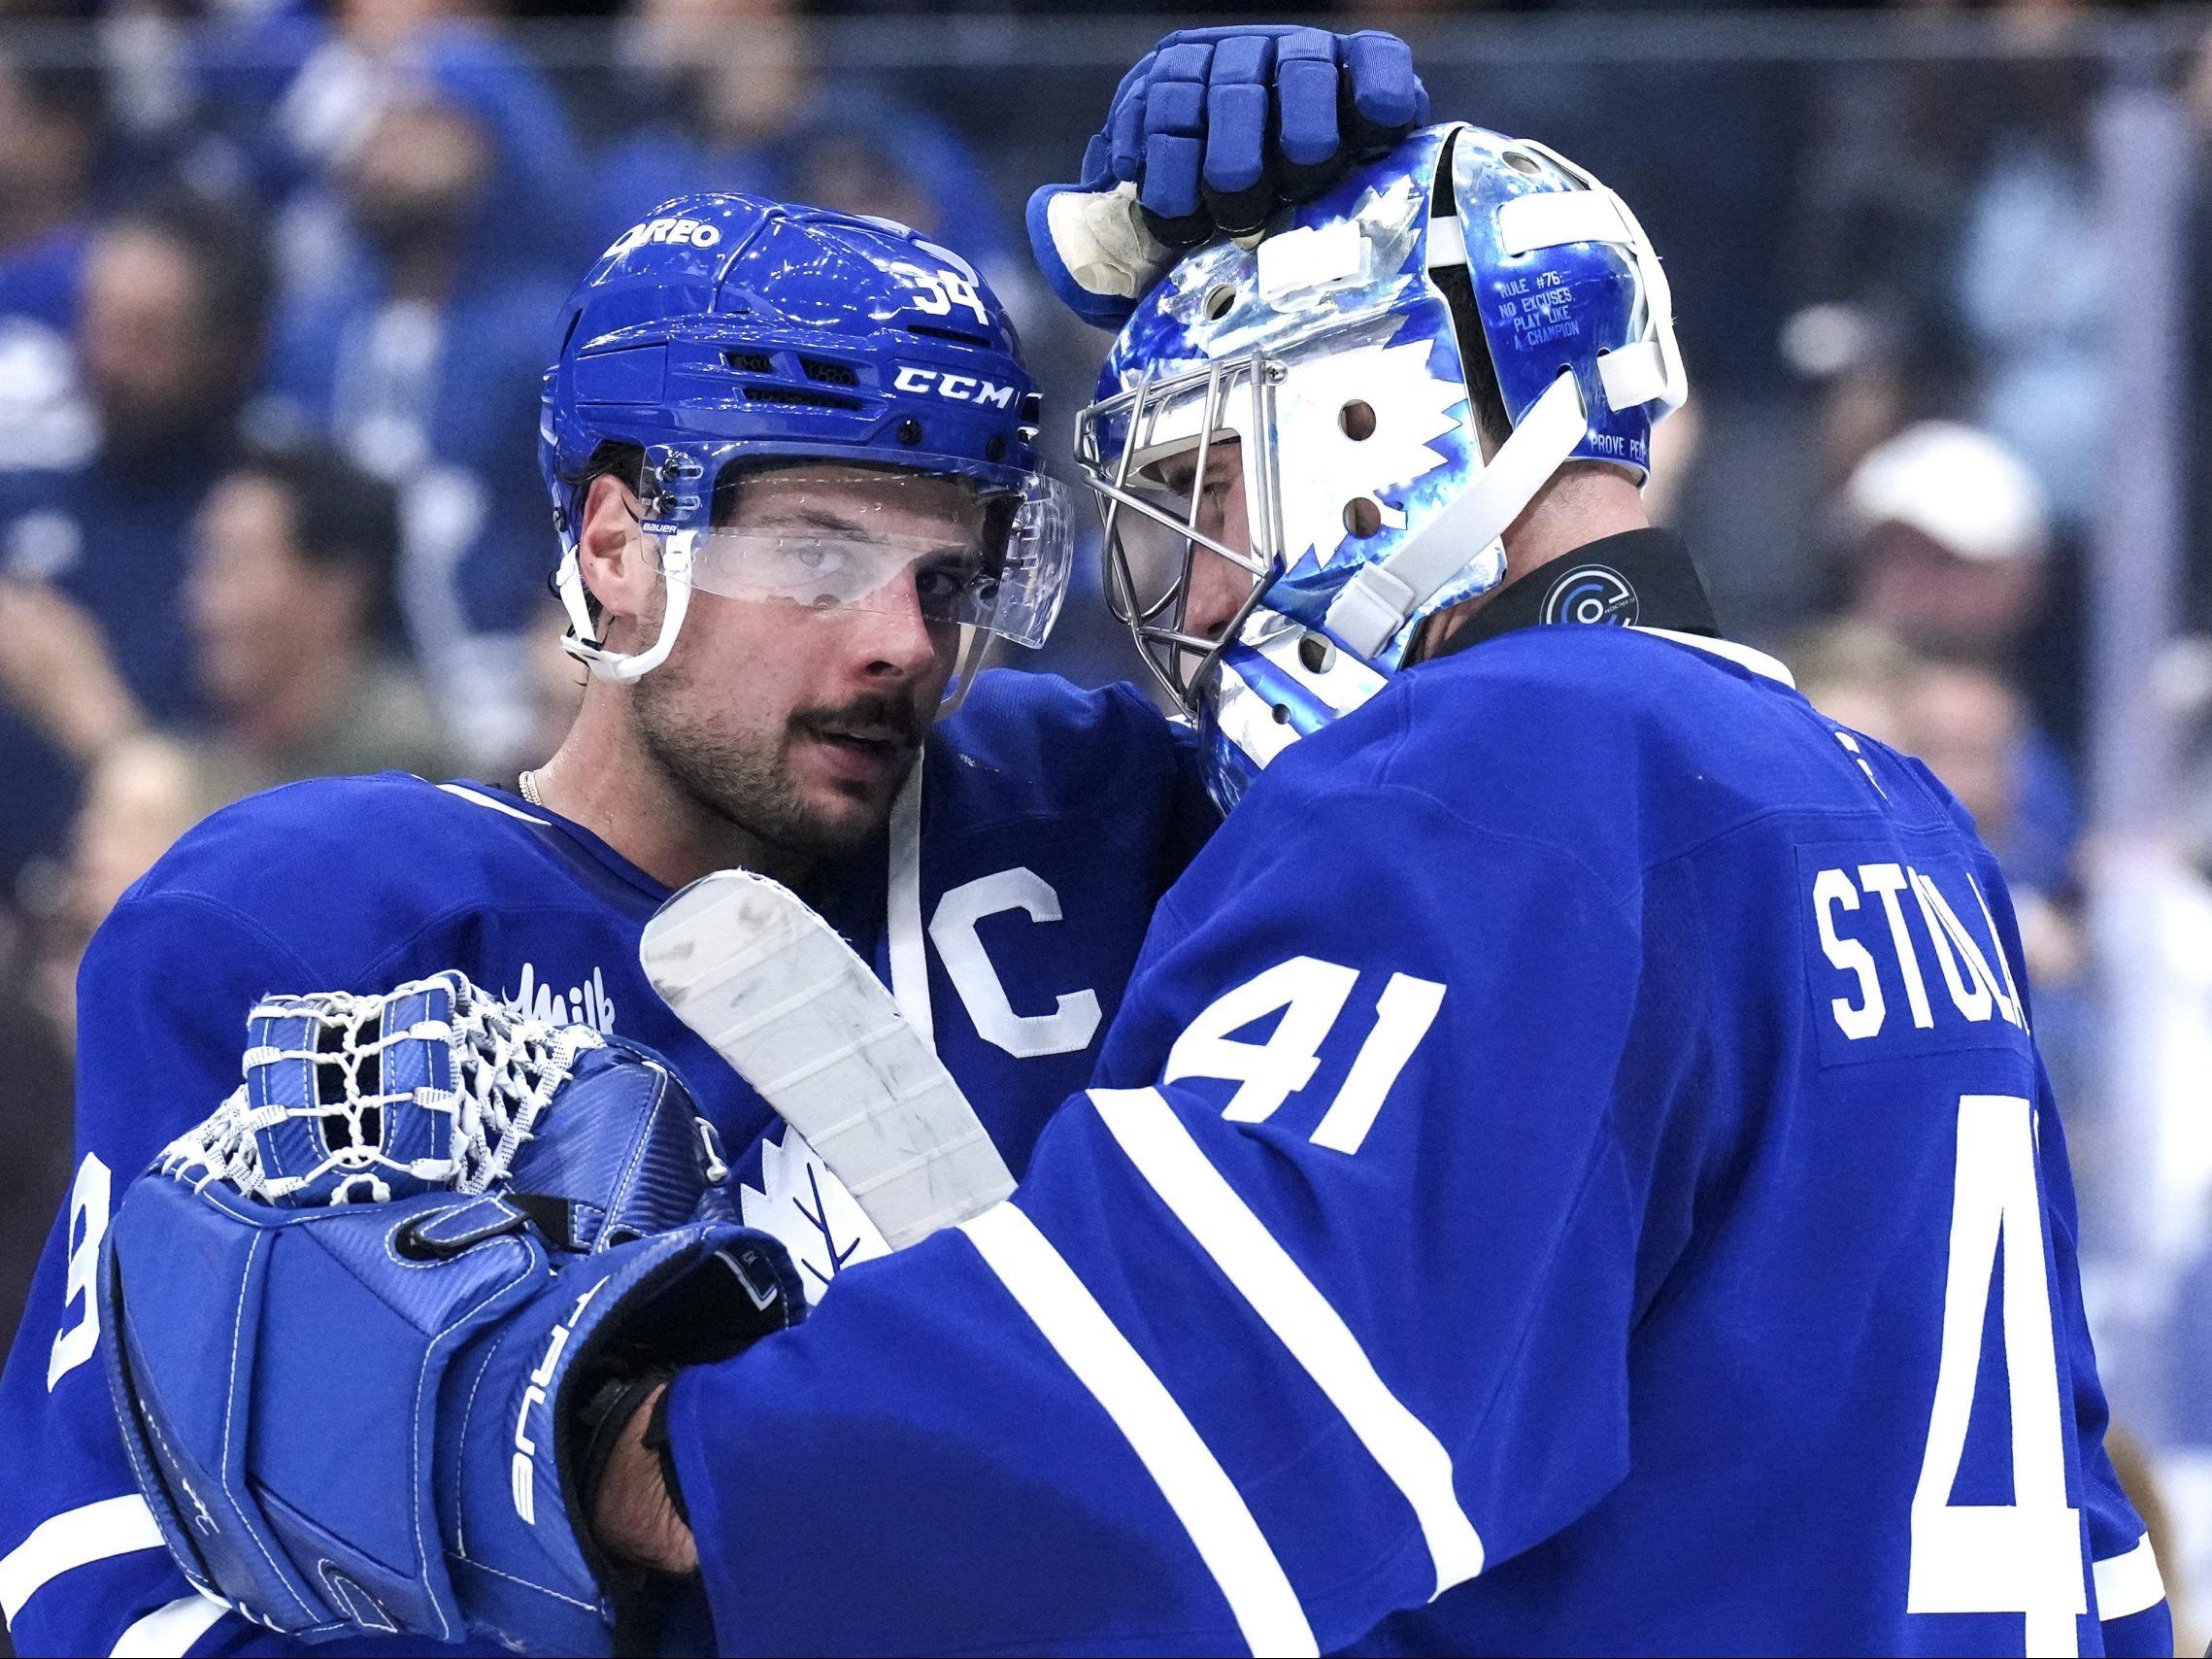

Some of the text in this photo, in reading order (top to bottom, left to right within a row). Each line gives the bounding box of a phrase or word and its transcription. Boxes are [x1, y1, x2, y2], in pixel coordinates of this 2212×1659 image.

[603, 218, 720, 258] OREO
[912, 269, 989, 326] 34
[1499, 278, 1529, 298] RULE
[1498, 302, 1517, 319] NO
[1513, 305, 1571, 332] PLAY LIKE
[1527, 321, 1580, 346] CHAMPION
[893, 366, 1015, 410] CCM
[1591, 433, 1625, 456] PROVE
[643, 523, 677, 533] BAUER
[928, 865, 1102, 1059] C
[1163, 955, 1447, 1156] 41
[1907, 1096, 2088, 1658] 4
